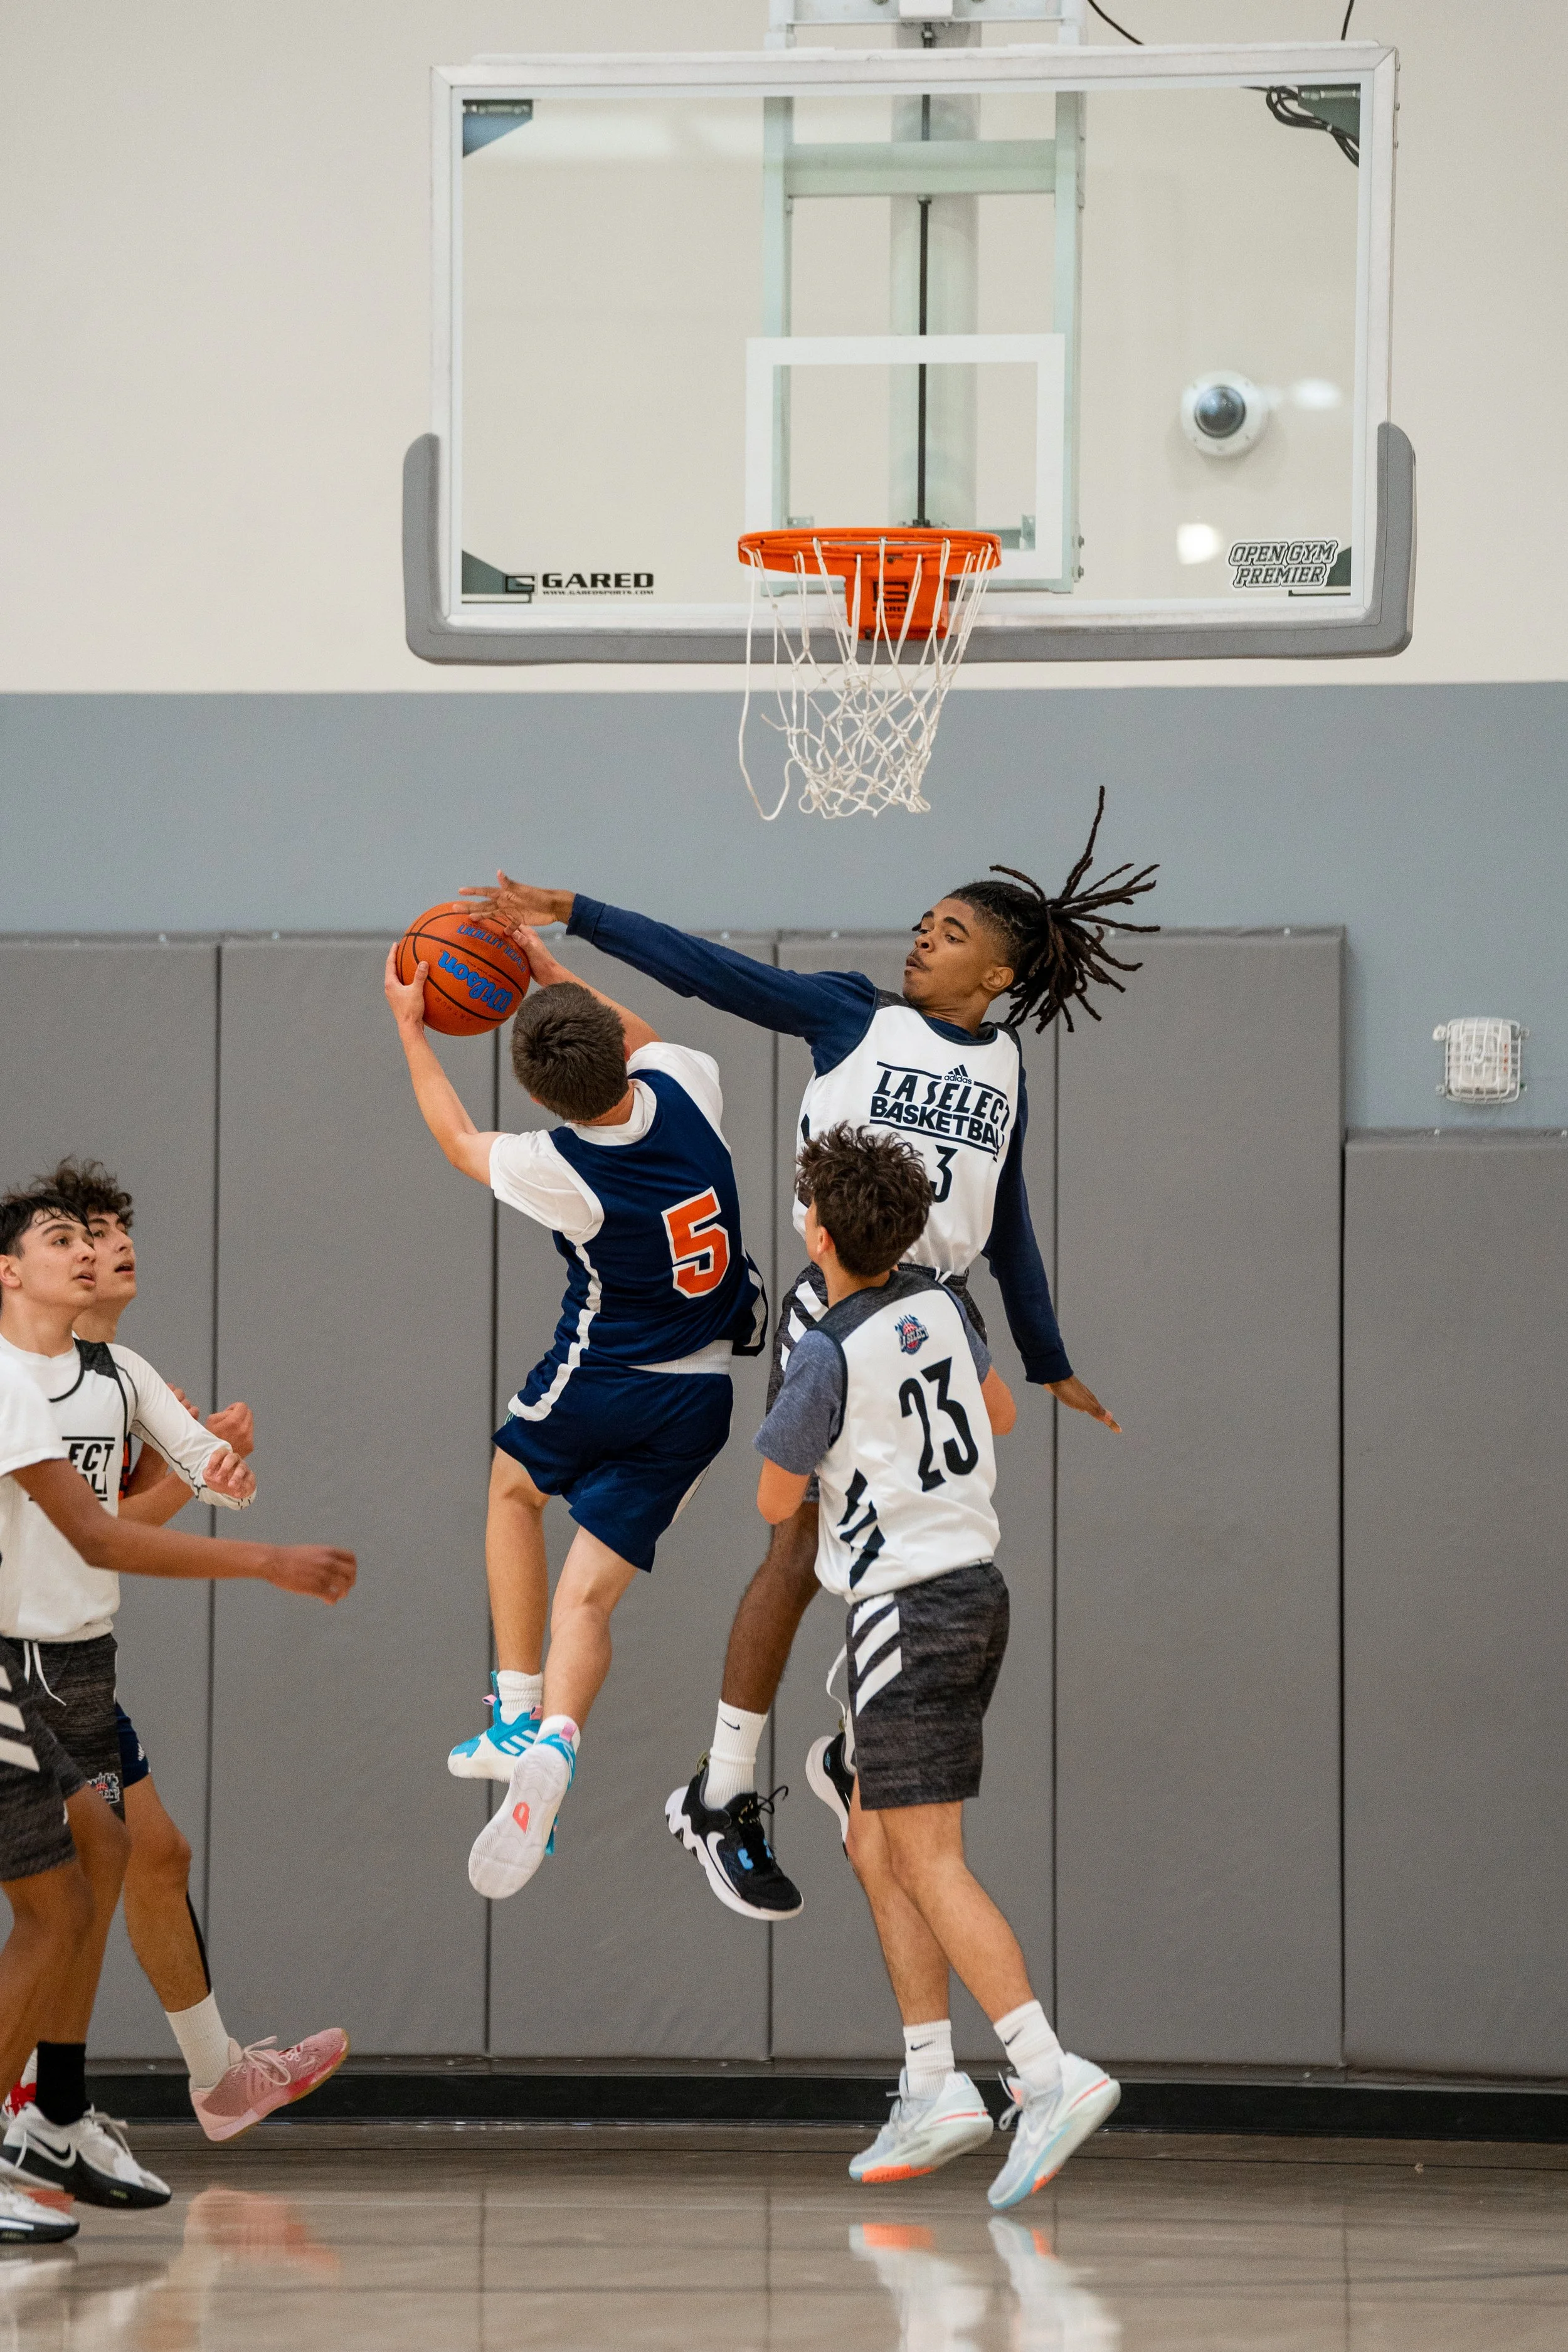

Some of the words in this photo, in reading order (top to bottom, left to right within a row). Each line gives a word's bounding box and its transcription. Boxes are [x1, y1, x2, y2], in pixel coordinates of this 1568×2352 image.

[1230, 543, 1288, 564] OPEN
[1287, 541, 1337, 563] GYM
[542, 573, 654, 588] GARED
[1234, 565, 1325, 586] PREMIER
[438, 950, 513, 1013] Wilson
[945, 1074, 972, 1084] adidas
[874, 1070, 918, 1103] LA
[921, 1080, 1010, 1131] SELECT
[661, 1185, 730, 1299] 5
[898, 1356, 978, 1492] 23
[68, 1443, 115, 1472] ECT
